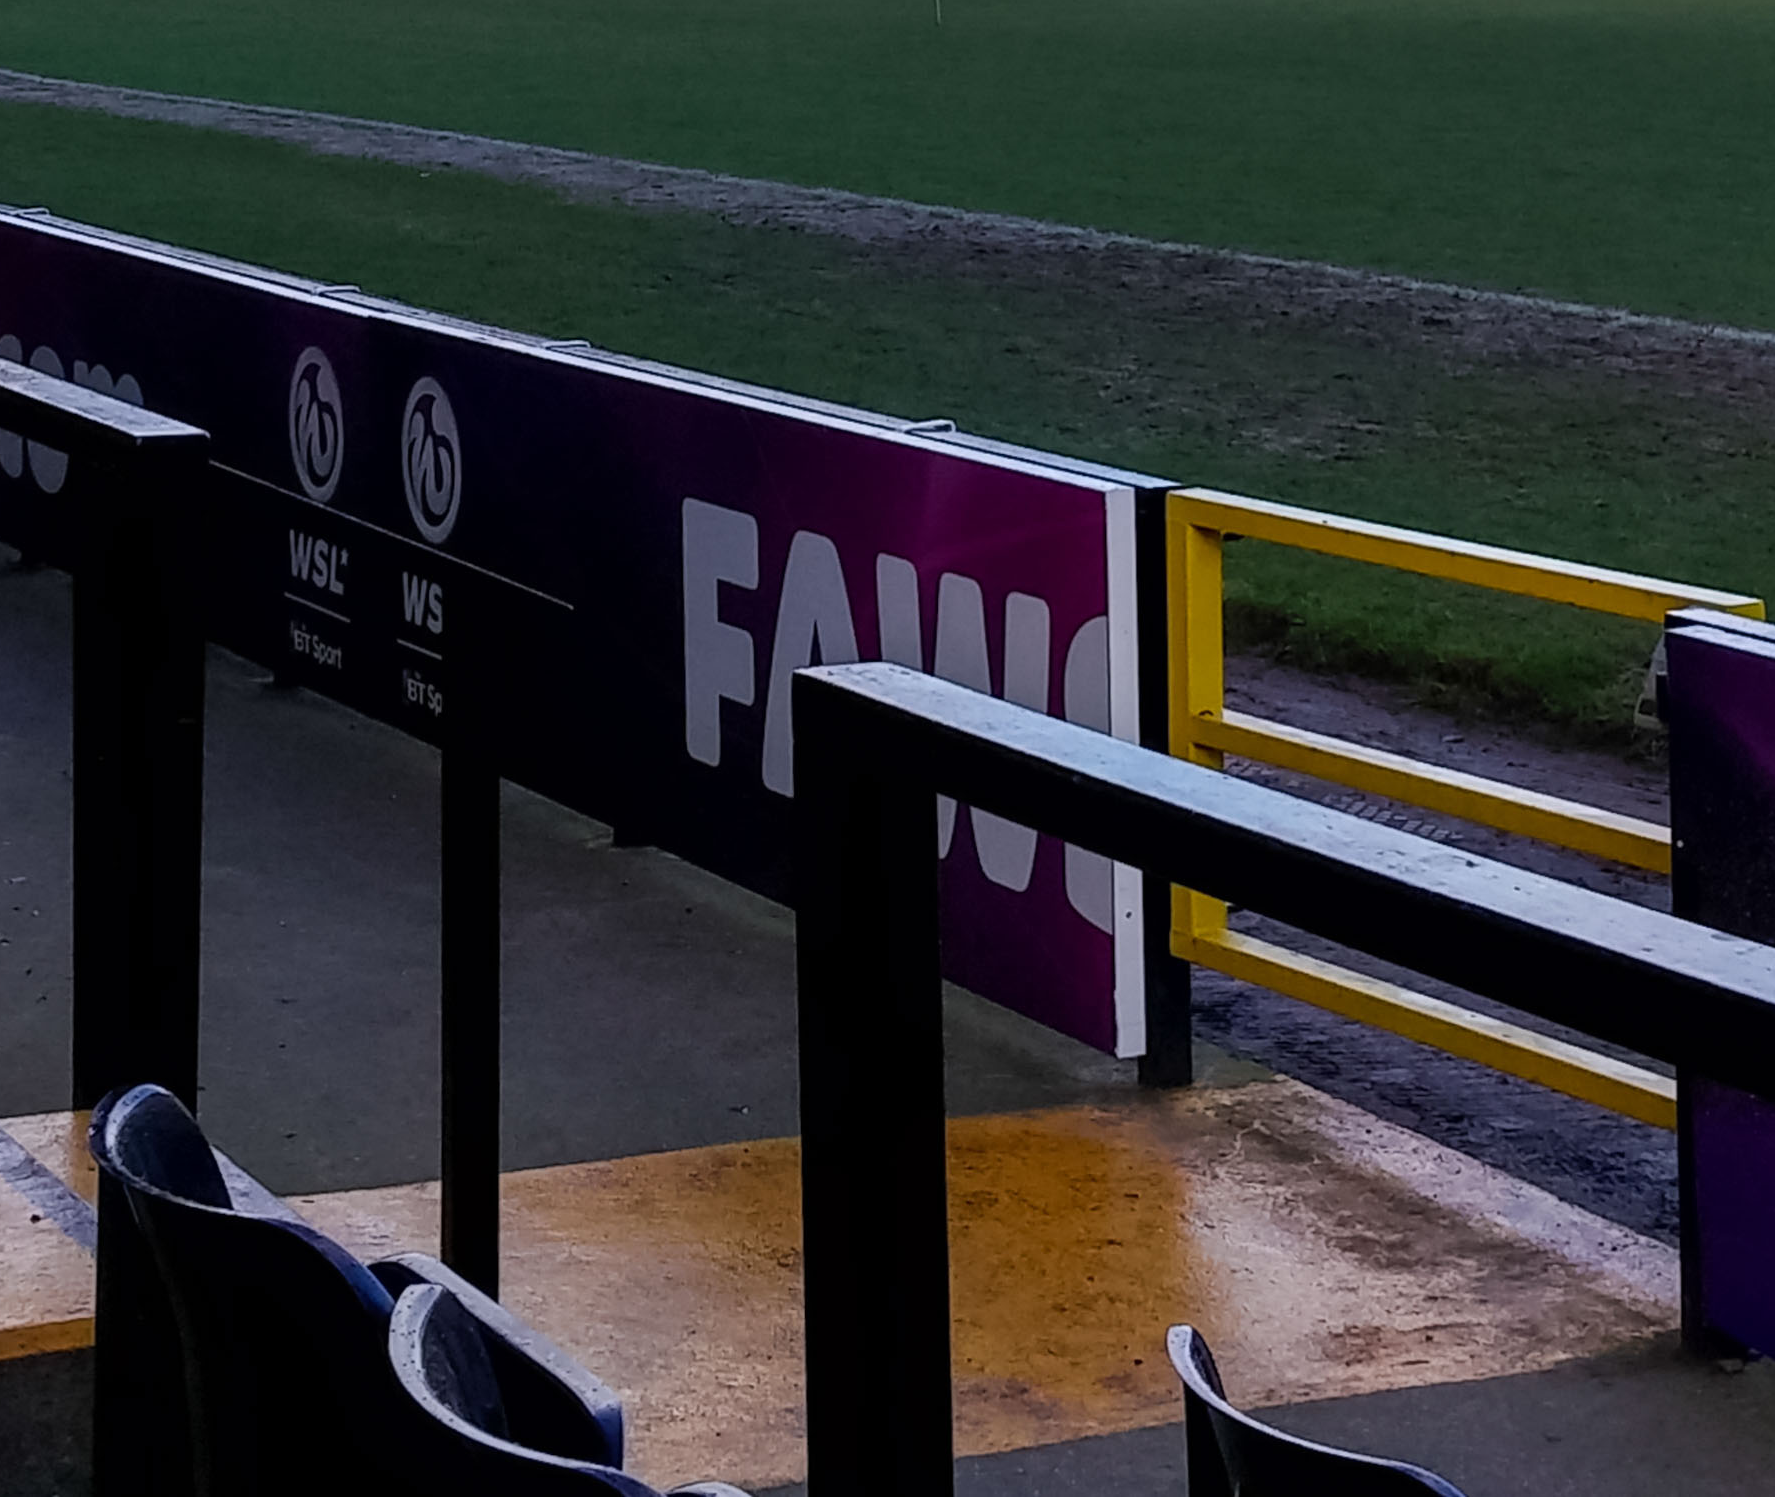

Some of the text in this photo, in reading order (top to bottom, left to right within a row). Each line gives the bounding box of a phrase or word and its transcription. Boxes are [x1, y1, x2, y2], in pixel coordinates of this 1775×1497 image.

[290, 528, 345, 595] WSL
[403, 571, 443, 635] WS
[313, 634, 342, 670] Sport
